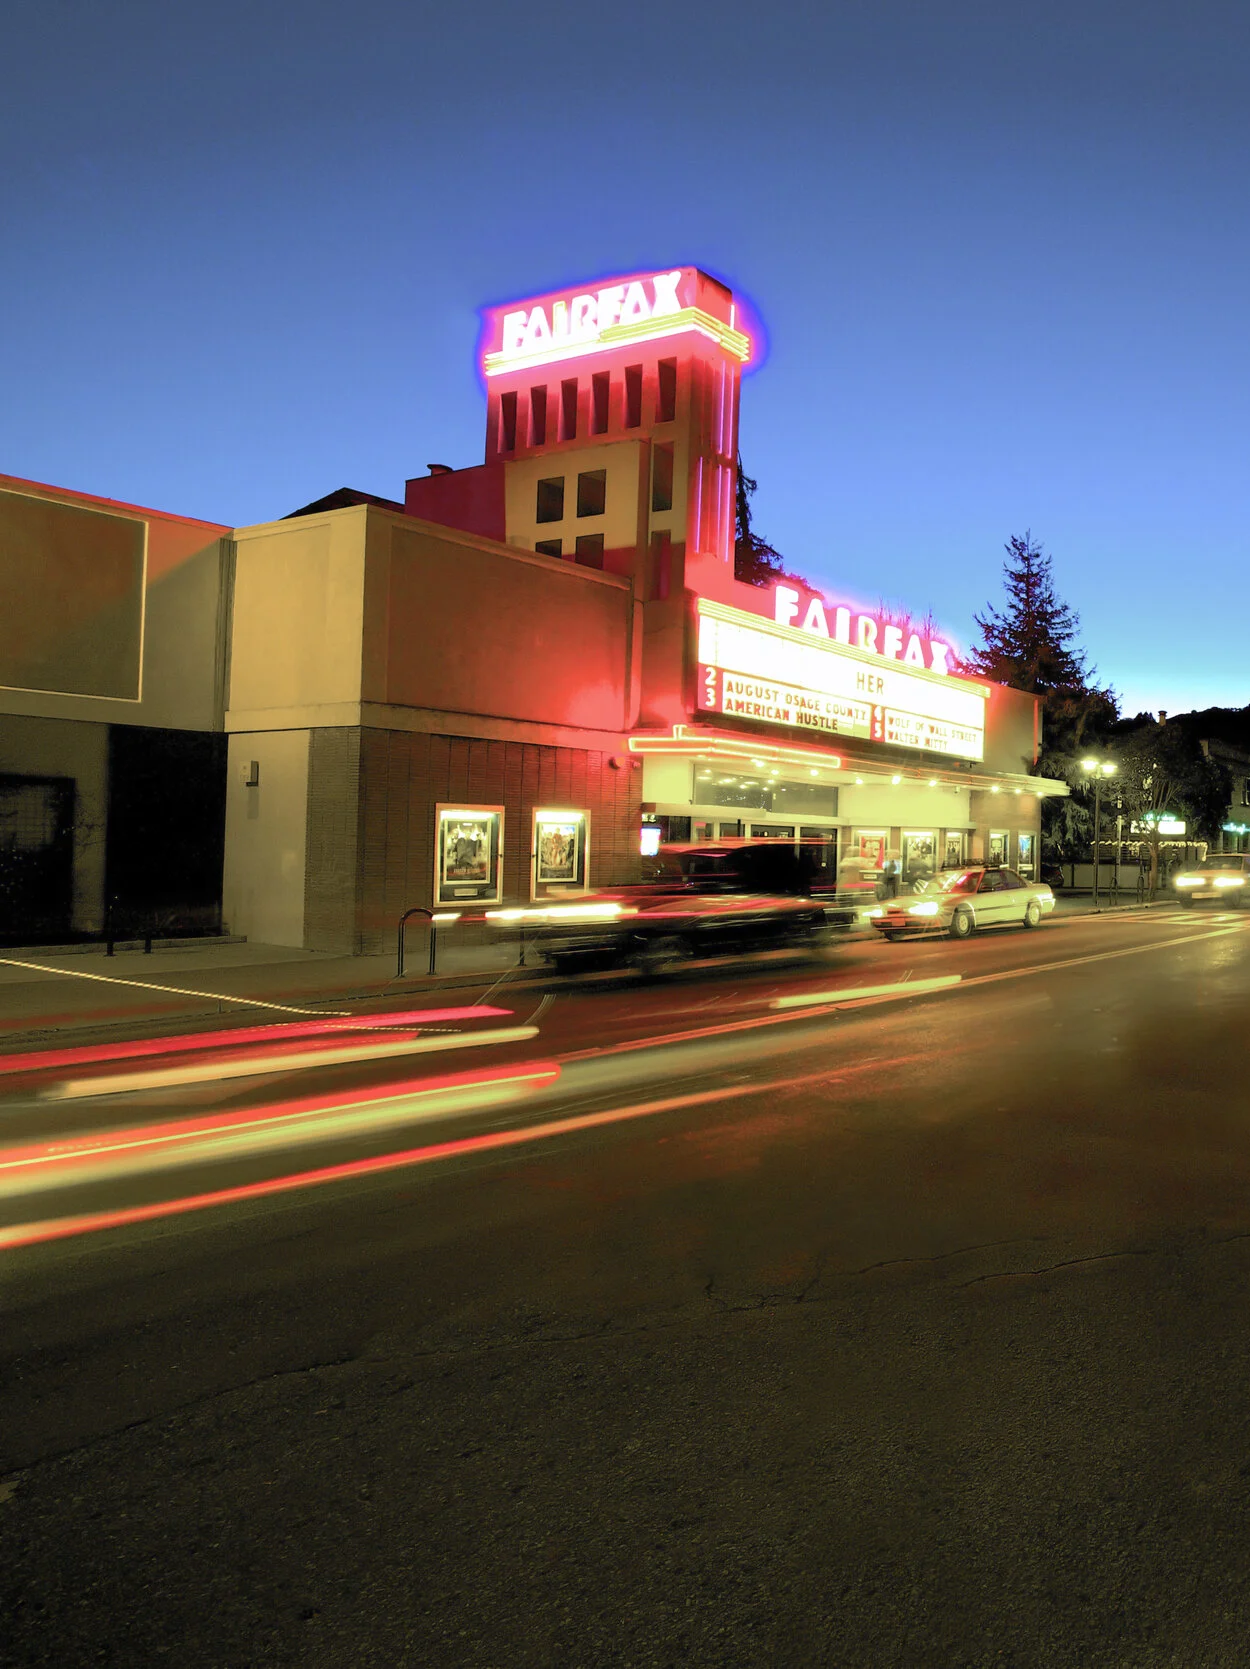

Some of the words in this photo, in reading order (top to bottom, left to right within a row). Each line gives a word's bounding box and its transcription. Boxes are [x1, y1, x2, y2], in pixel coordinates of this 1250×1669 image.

[503, 271, 682, 352] FAIRFAX
[775, 585, 950, 676] FAIRFAX
[704, 667, 717, 686] 2
[856, 671, 885, 695] HER
[705, 688, 716, 707] 3
[726, 680, 779, 702] AUGUST
[785, 693, 820, 711] OSAGE
[826, 702, 867, 721] COUNTY
[725, 698, 790, 721] AMERICAN
[796, 712, 838, 730] HUSTLE
[874, 722, 883, 738] 5
[888, 716, 911, 729] WOLF
[916, 721, 925, 731] OF
[928, 724, 947, 737] WALL
[951, 729, 977, 744] STREET
[888, 730, 919, 745] WALTER
[924, 736, 949, 751] MITTY
